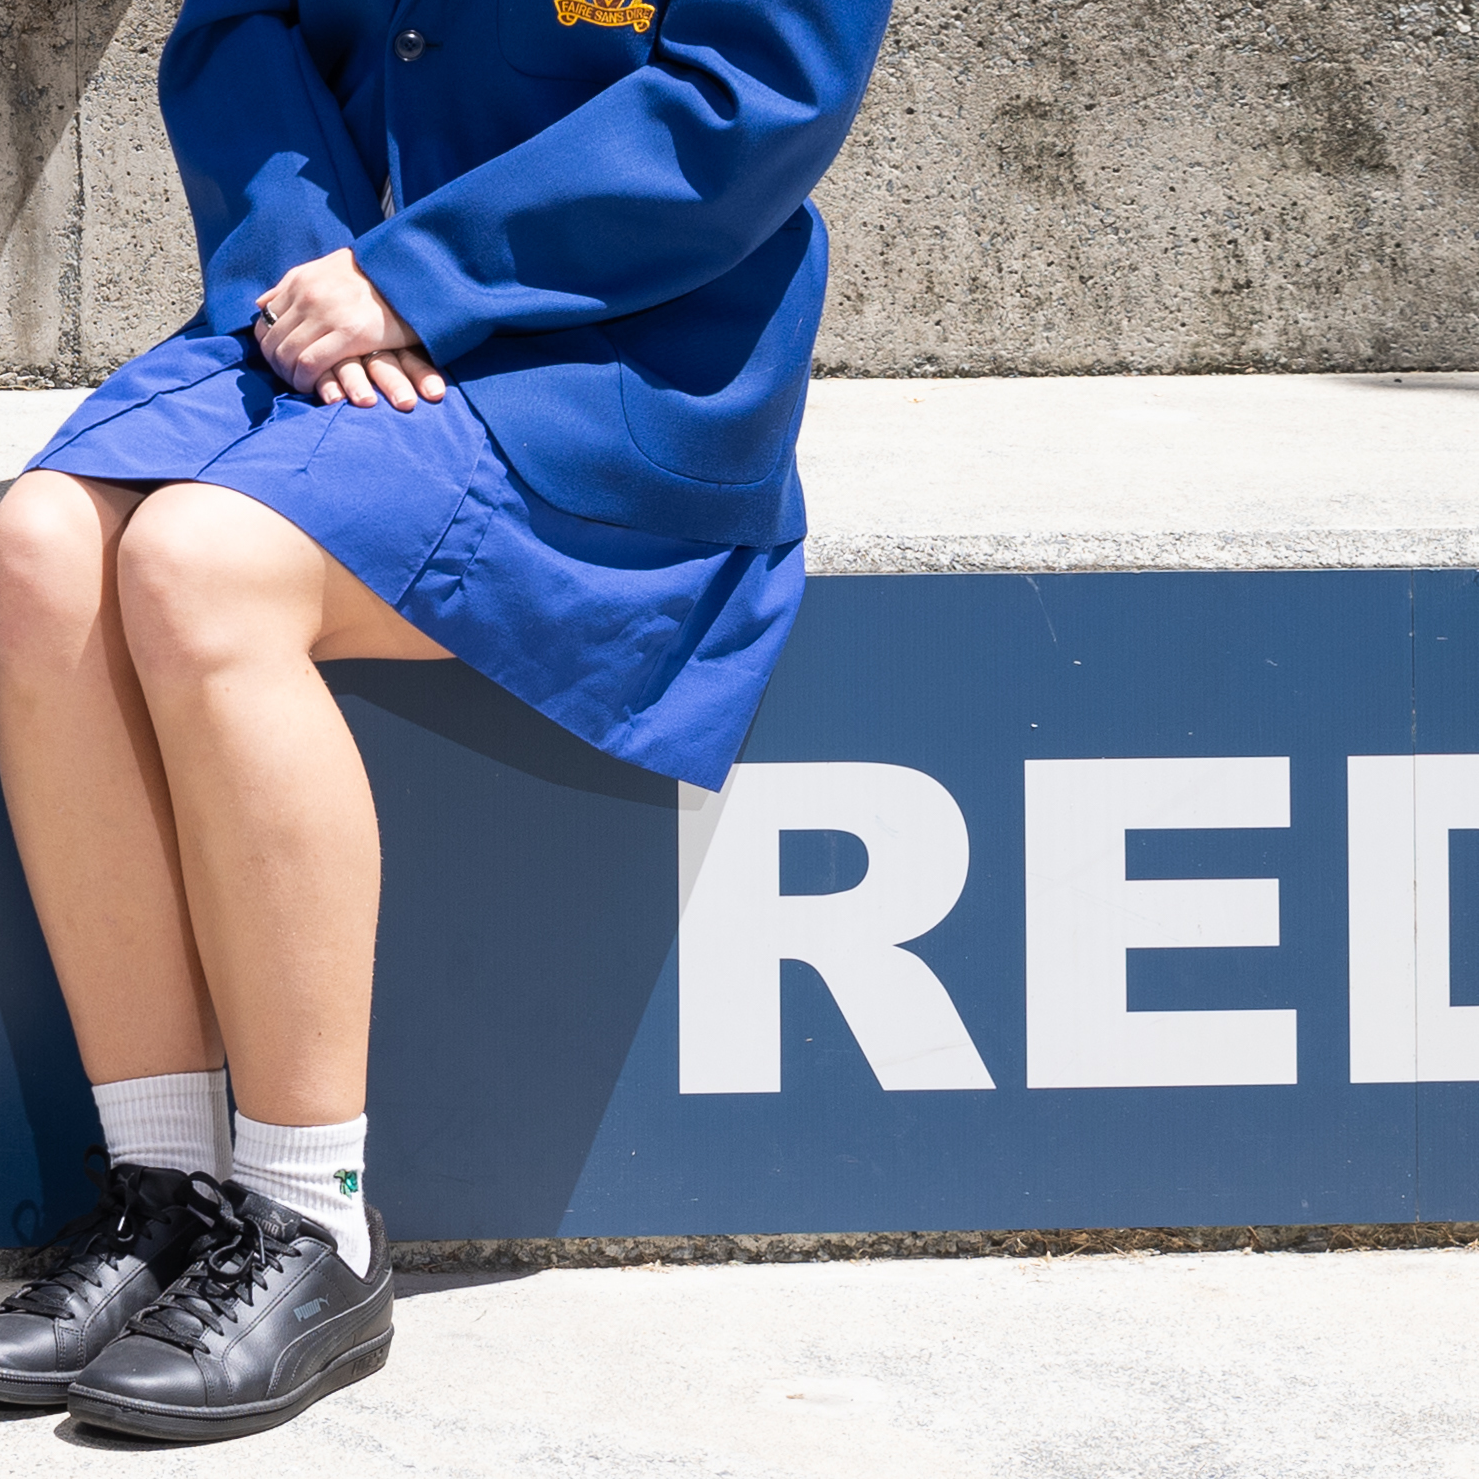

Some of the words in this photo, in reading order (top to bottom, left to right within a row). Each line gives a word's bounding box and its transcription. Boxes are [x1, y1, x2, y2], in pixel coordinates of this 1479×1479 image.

[562, 1, 593, 18] FAIRE
[594, 10, 625, 23] SANS
[626, 7, 651, 20] DIRE
